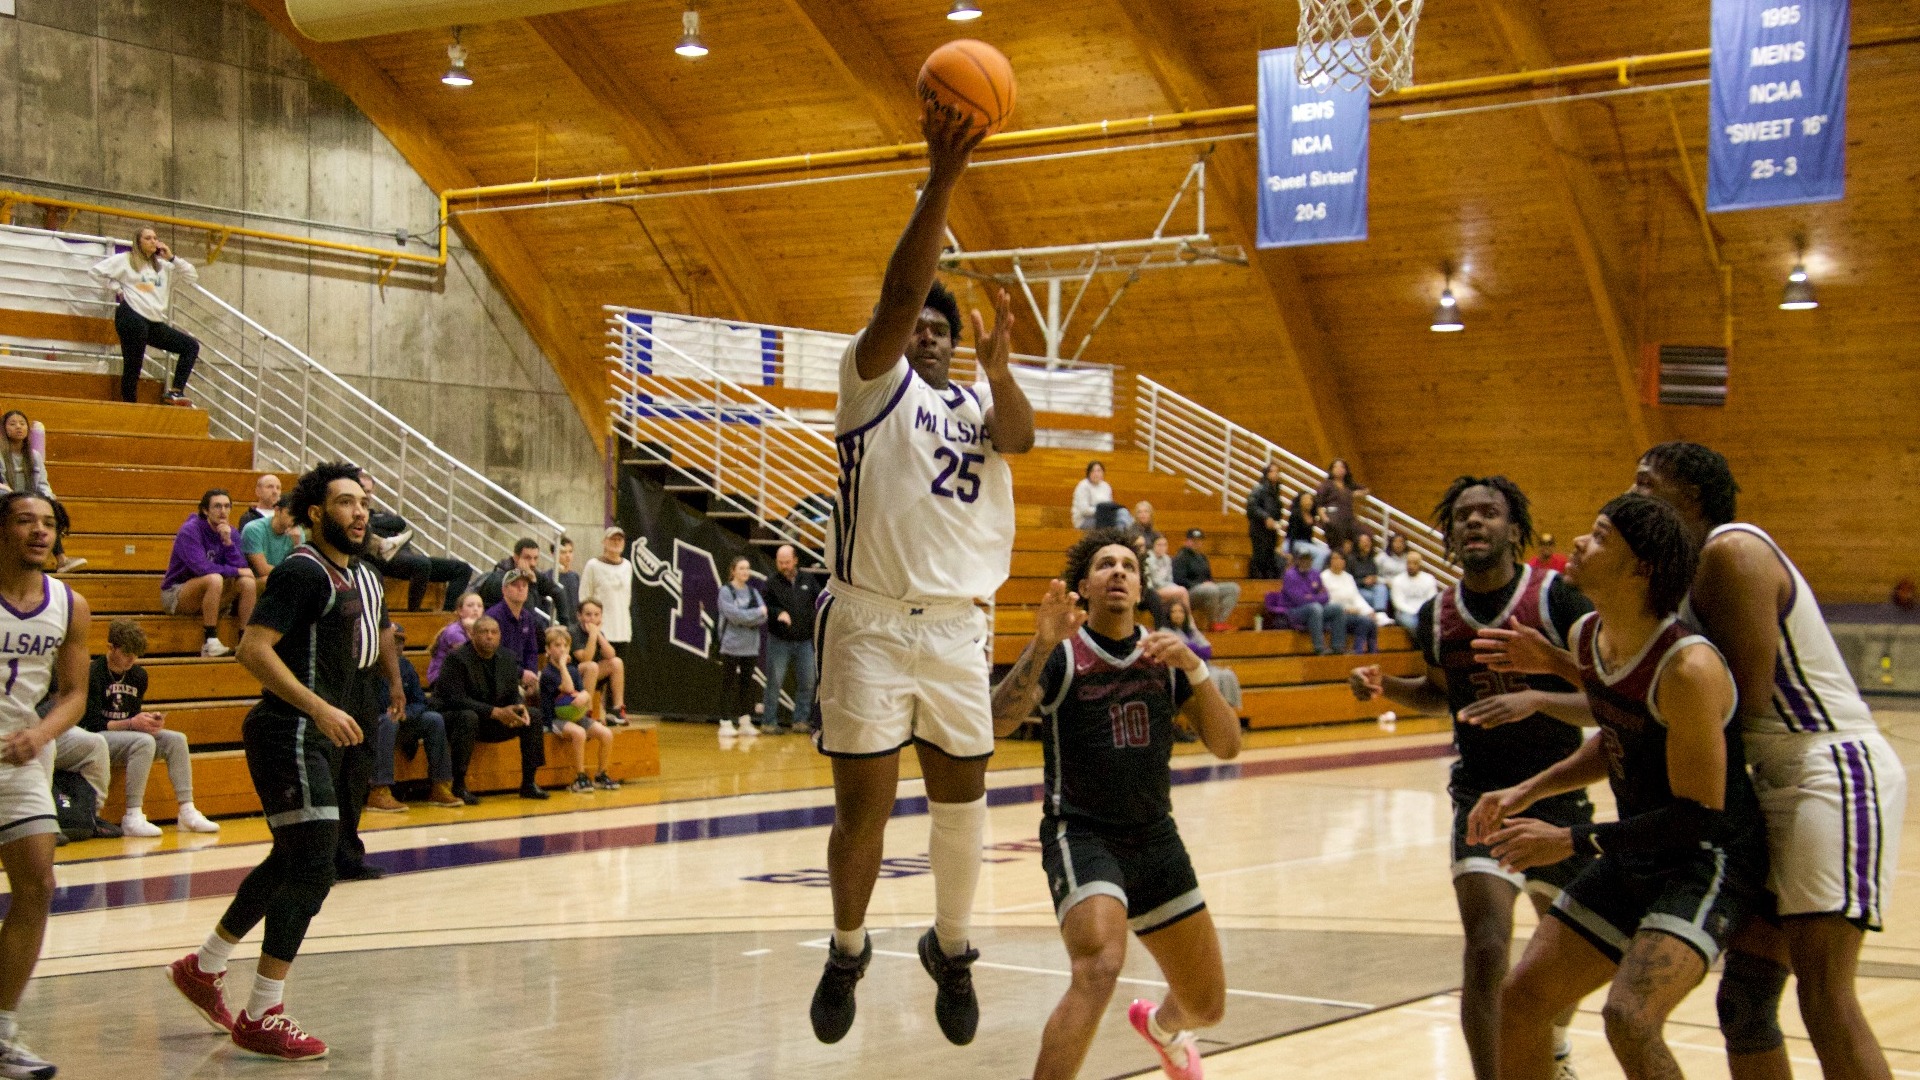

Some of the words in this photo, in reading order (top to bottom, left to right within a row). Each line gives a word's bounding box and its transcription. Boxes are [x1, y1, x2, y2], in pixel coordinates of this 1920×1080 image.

[1761, 5, 1800, 29] 1995
[1751, 41, 1806, 67] MEN'S
[1749, 80, 1803, 104] NCAA
[1291, 100, 1335, 124] MEN'S
[1291, 134, 1332, 156] NCAA
[1295, 202, 1327, 222] 20-6
[931, 446, 985, 503] 25
[5, 657, 19, 695] 1
[1108, 700, 1150, 749] 10
